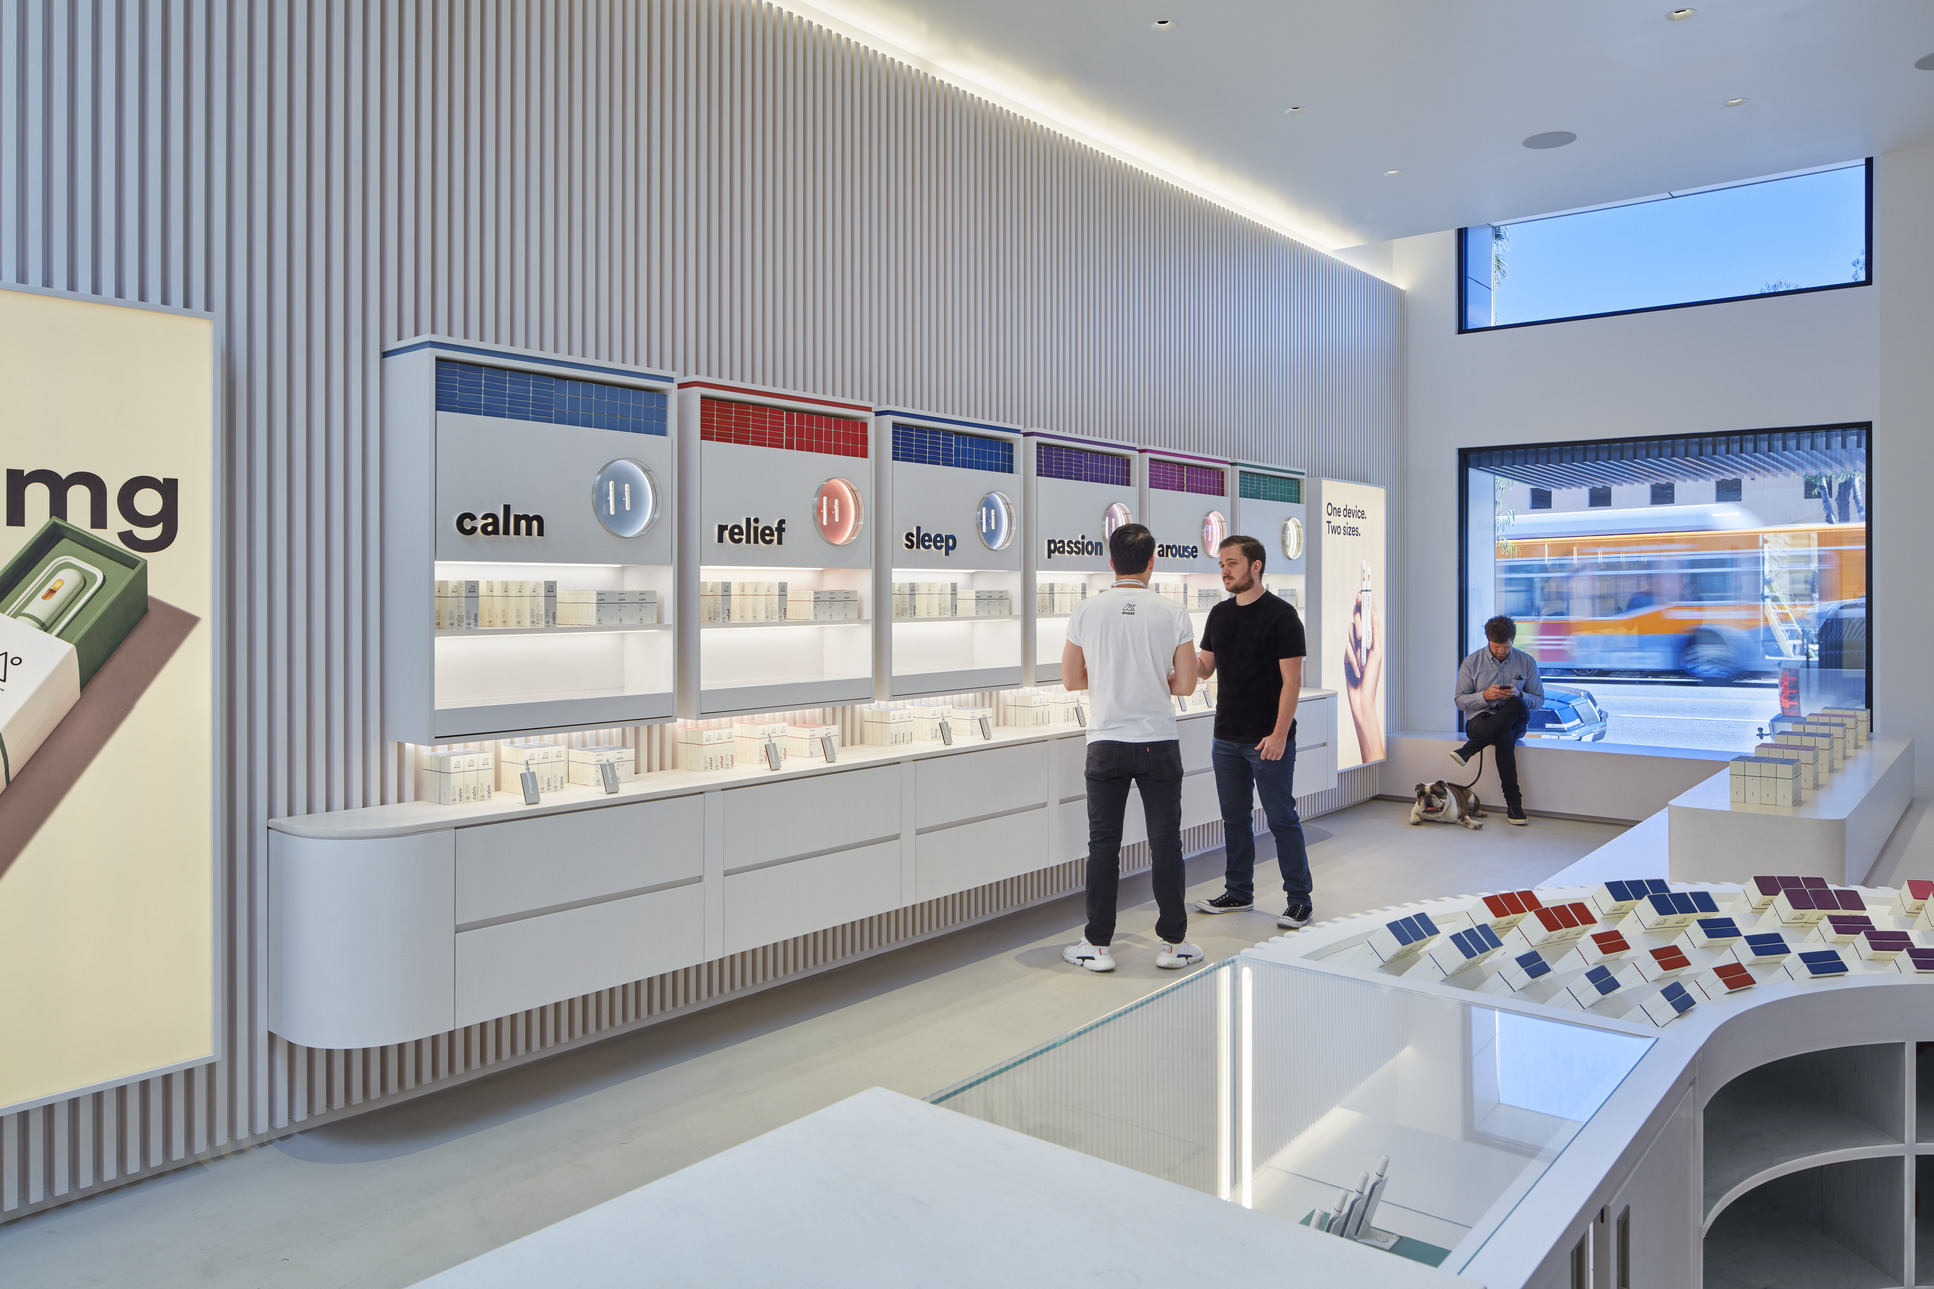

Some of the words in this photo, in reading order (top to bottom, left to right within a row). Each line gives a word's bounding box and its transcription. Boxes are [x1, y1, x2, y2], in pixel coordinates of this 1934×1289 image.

[6, 468, 179, 553] mg
[455, 504, 544, 537] calm
[1327, 502, 1341, 517] One
[1343, 504, 1367, 520] device.
[718, 517, 785, 545] relief
[905, 526, 957, 557] sleep
[1326, 520, 1341, 535] Two
[1343, 522, 1361, 537] sizes.
[1047, 535, 1103, 559] passion
[1157, 543, 1198, 559] arouse
